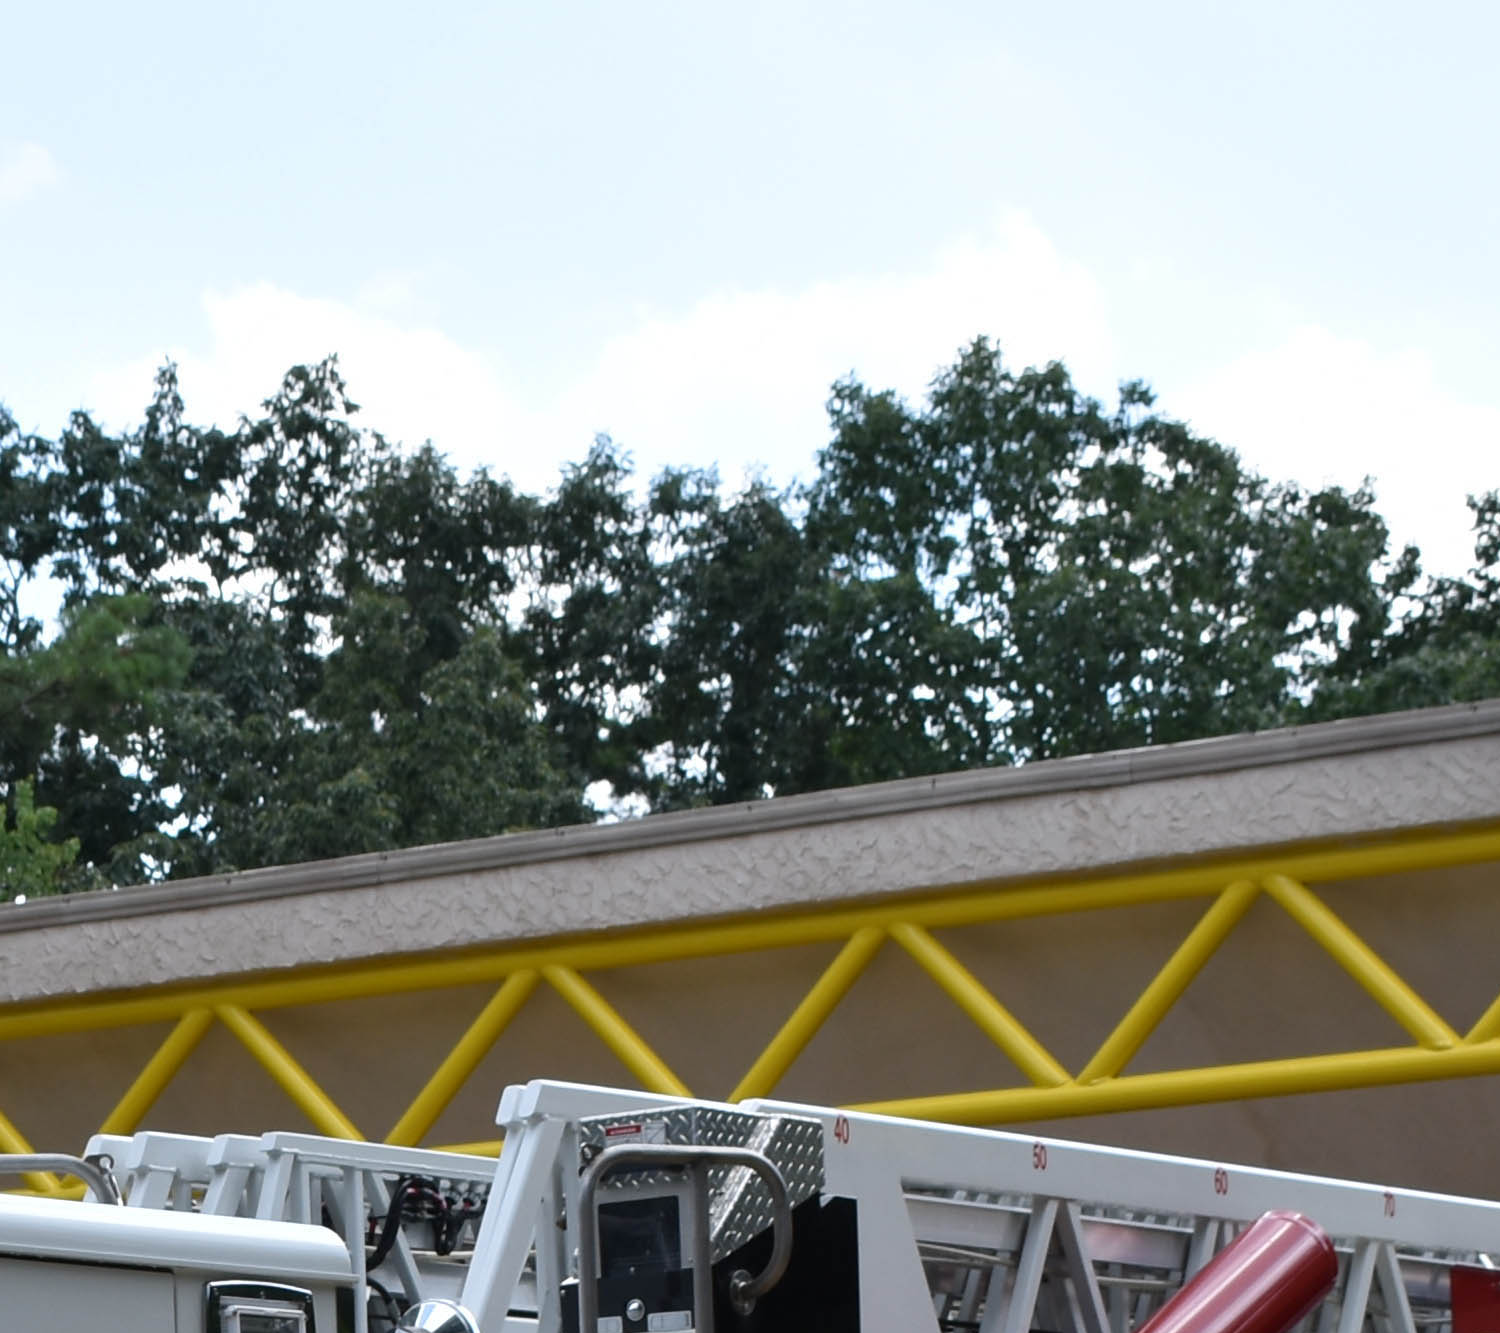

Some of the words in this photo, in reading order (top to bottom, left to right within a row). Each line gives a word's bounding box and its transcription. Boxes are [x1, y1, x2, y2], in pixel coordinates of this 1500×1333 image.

[834, 1114, 850, 1145] 40
[1032, 1142, 1048, 1171] 50
[1213, 1167, 1229, 1196] 60
[1383, 1191, 1396, 1219] 70
